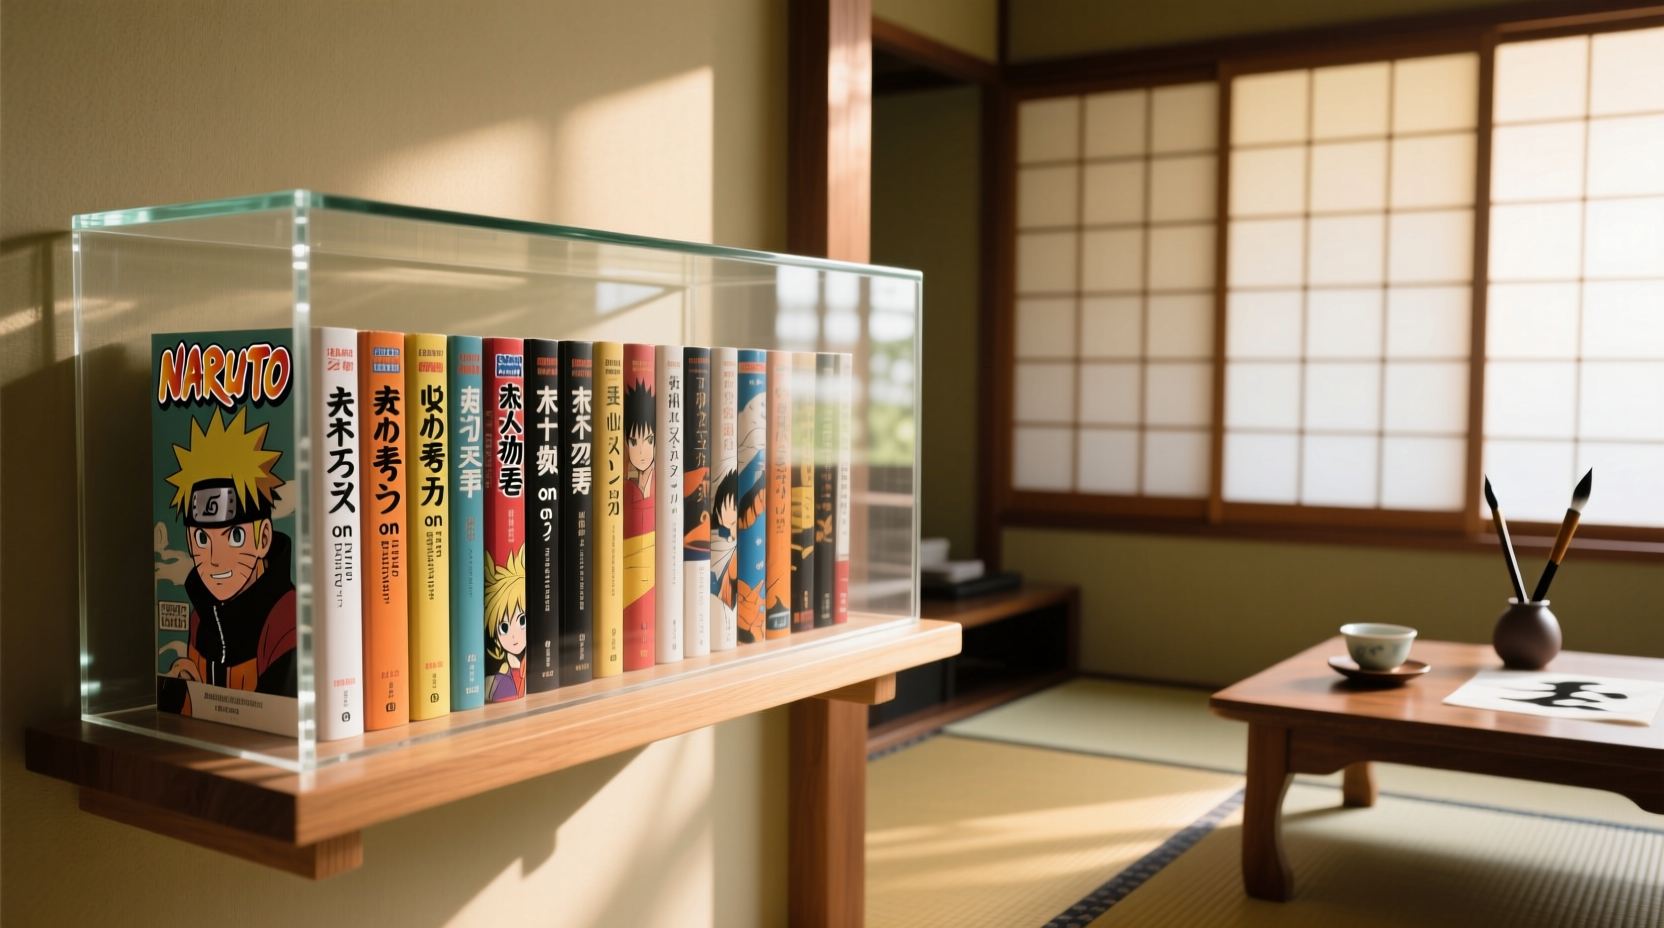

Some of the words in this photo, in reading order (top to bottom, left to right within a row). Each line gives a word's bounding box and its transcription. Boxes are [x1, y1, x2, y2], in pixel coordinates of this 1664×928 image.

[157, 342, 291, 410] NARUTO
[538, 487, 557, 501] on
[424, 514, 443, 528] on
[332, 525, 352, 537] on
[379, 522, 399, 536] on
